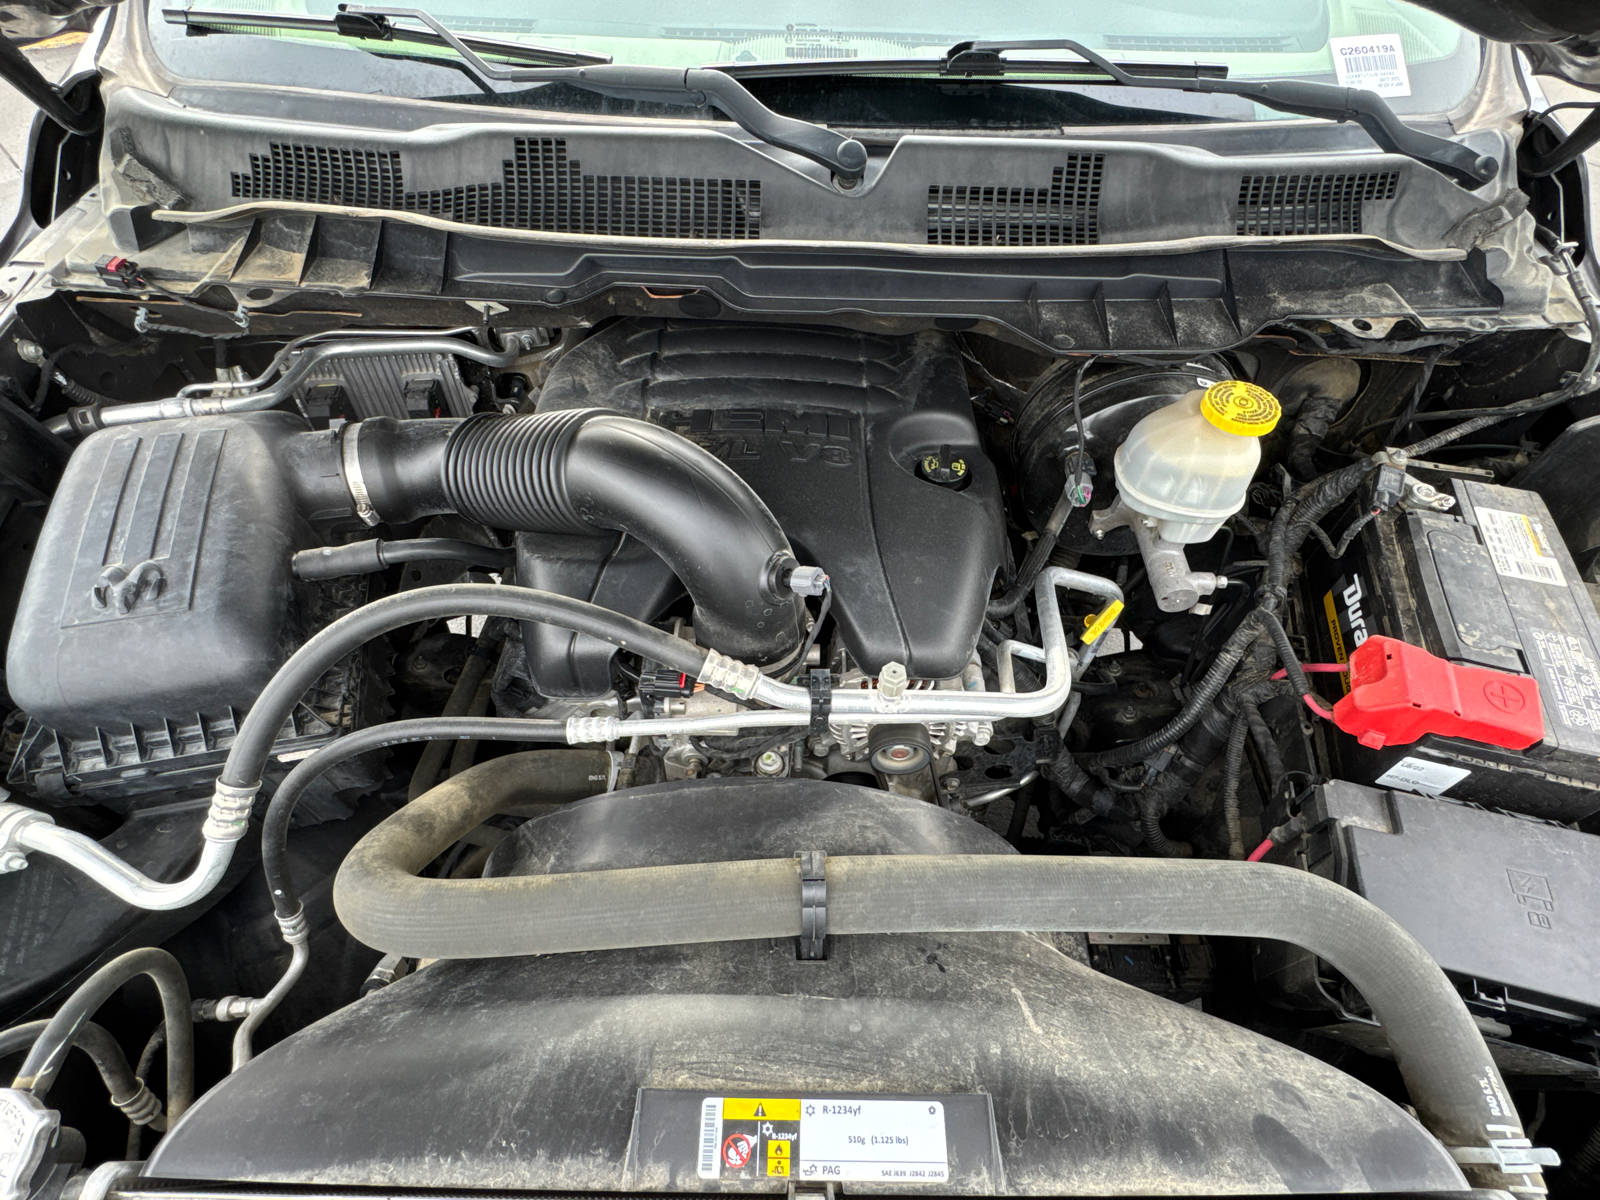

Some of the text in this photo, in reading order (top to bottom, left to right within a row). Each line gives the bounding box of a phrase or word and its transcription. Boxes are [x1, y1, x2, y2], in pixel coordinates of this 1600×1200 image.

[1340, 45, 1396, 56] G260419A
[1342, 573, 1369, 648] Dura
[1331, 619, 1345, 661] PROVEN
[822, 1105, 862, 1117] R-1234yf
[1485, 1095, 1502, 1116] RAD
[771, 1132, 798, 1141] R-1234yf
[848, 1135, 909, 1146] 510g (1.125 lbs)
[822, 1166, 841, 1175] PAG
[928, 1170, 945, 1178] J2845
